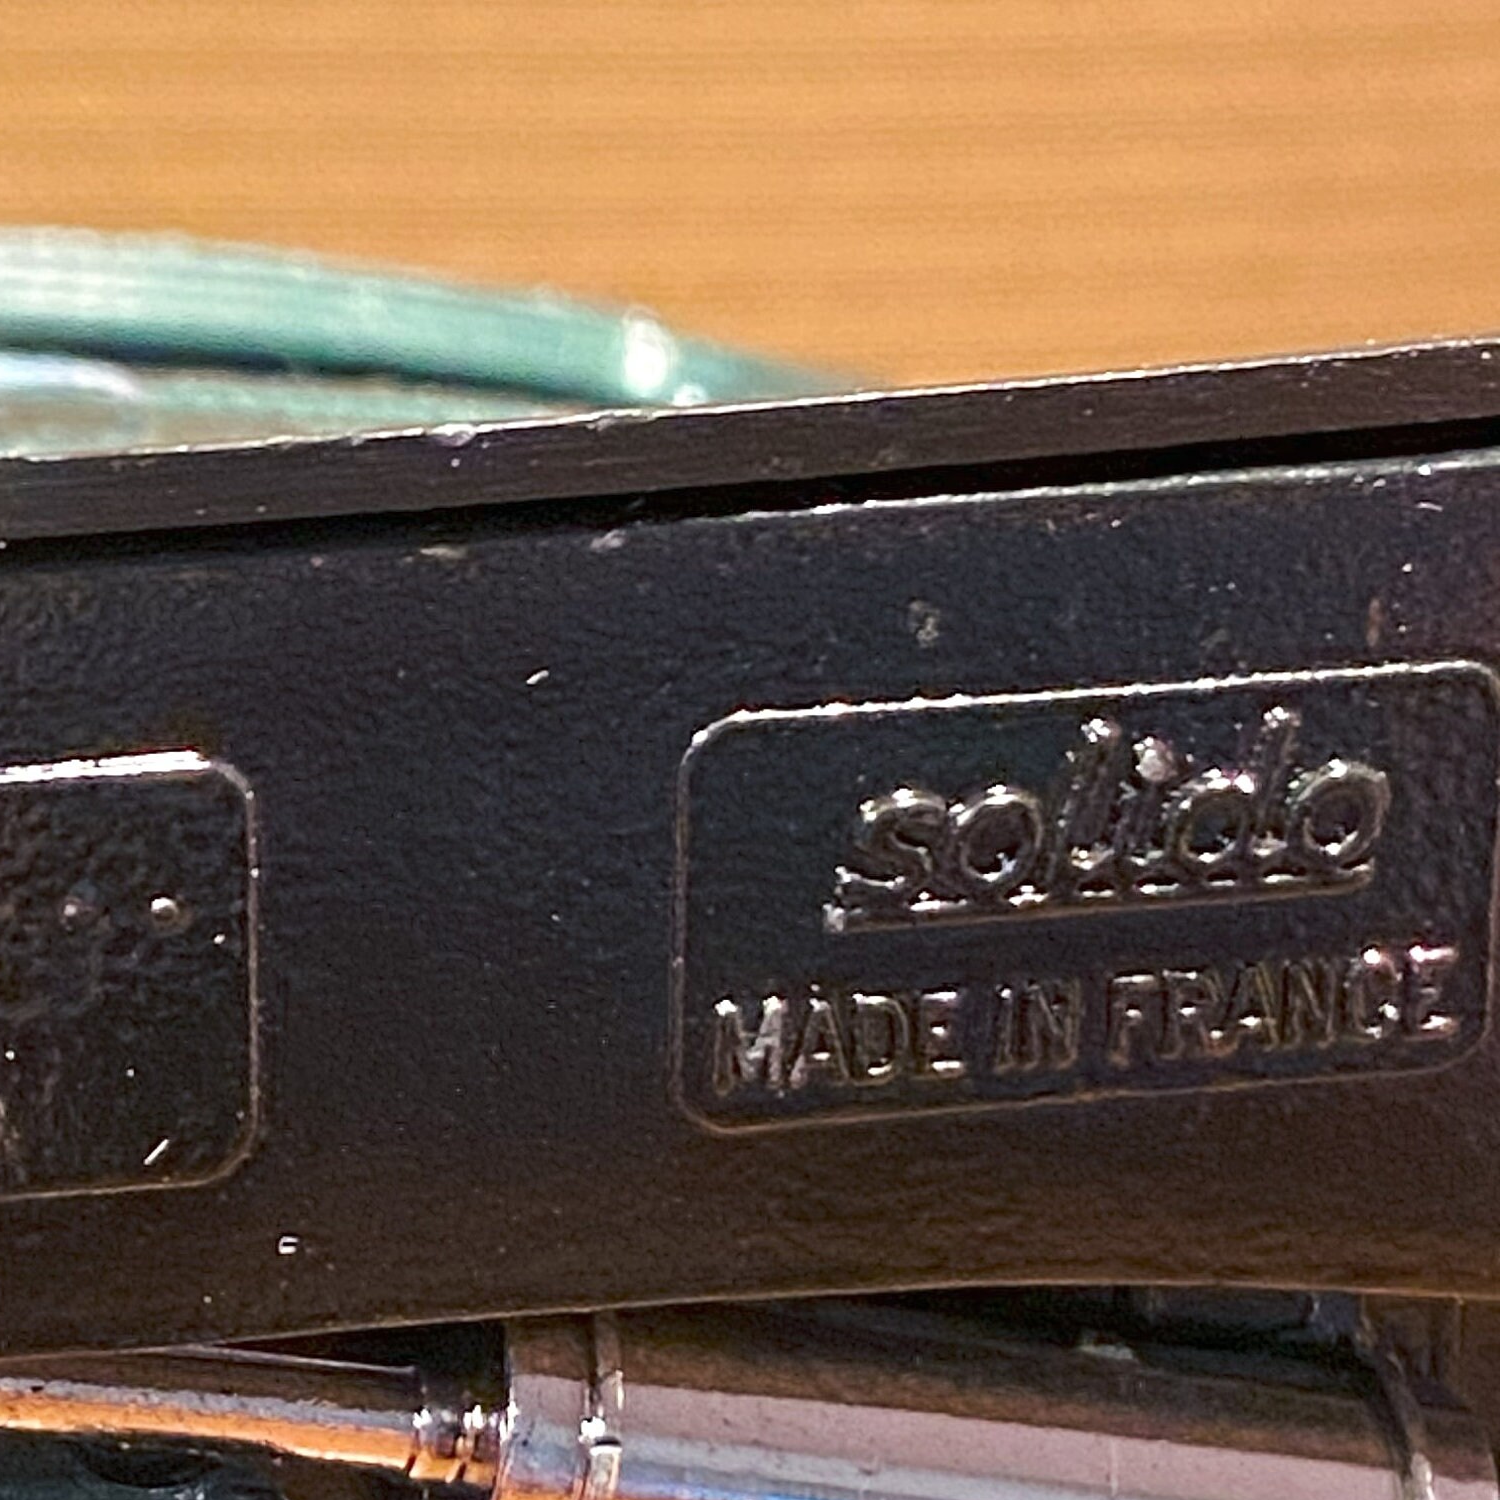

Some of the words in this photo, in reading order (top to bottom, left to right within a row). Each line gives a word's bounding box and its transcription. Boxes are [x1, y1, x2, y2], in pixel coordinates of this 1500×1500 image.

[828, 704, 1392, 900] solido
[710, 987, 966, 1097] MADE
[994, 976, 1086, 1078] IN
[1104, 942, 1462, 1068] FRANCE
